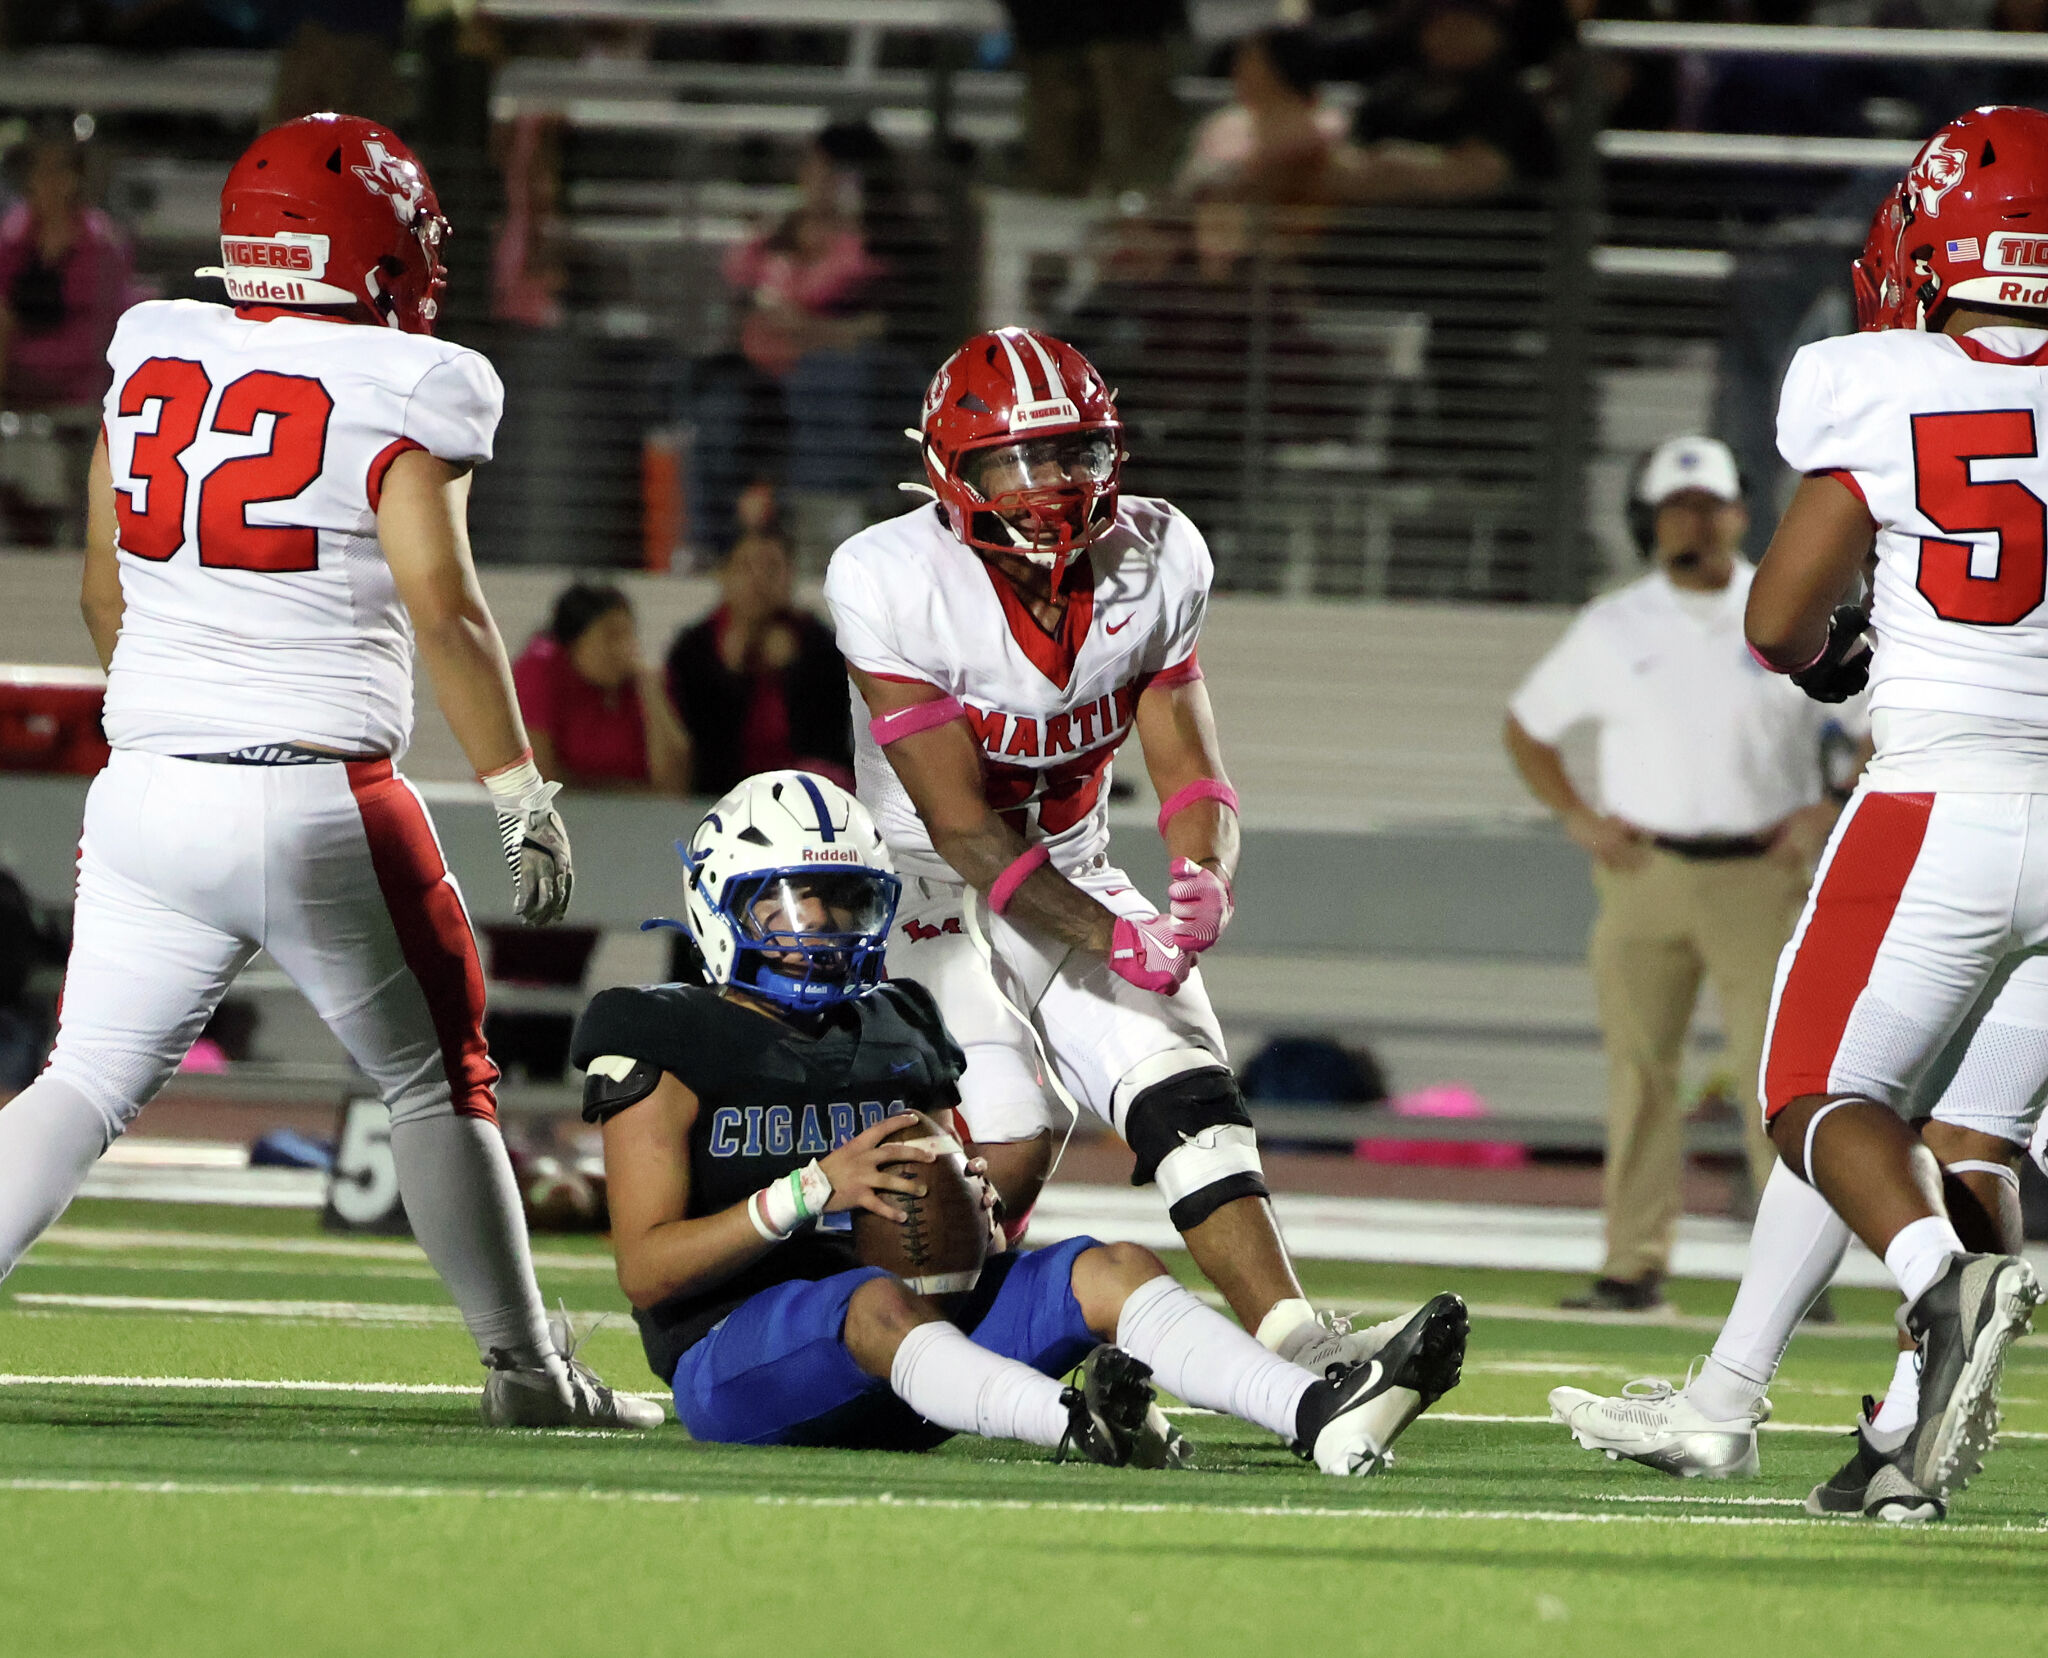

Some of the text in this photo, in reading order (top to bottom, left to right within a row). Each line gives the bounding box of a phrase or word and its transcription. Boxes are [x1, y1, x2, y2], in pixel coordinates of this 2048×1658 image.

[222, 241, 313, 271] TIGERS
[228, 279, 305, 301] Riddell
[114, 356, 335, 573] 32
[1910, 408, 2048, 626] 5
[802, 849, 858, 862] Riddell
[793, 983, 828, 994] Rddell
[333, 1099, 398, 1222] 5
